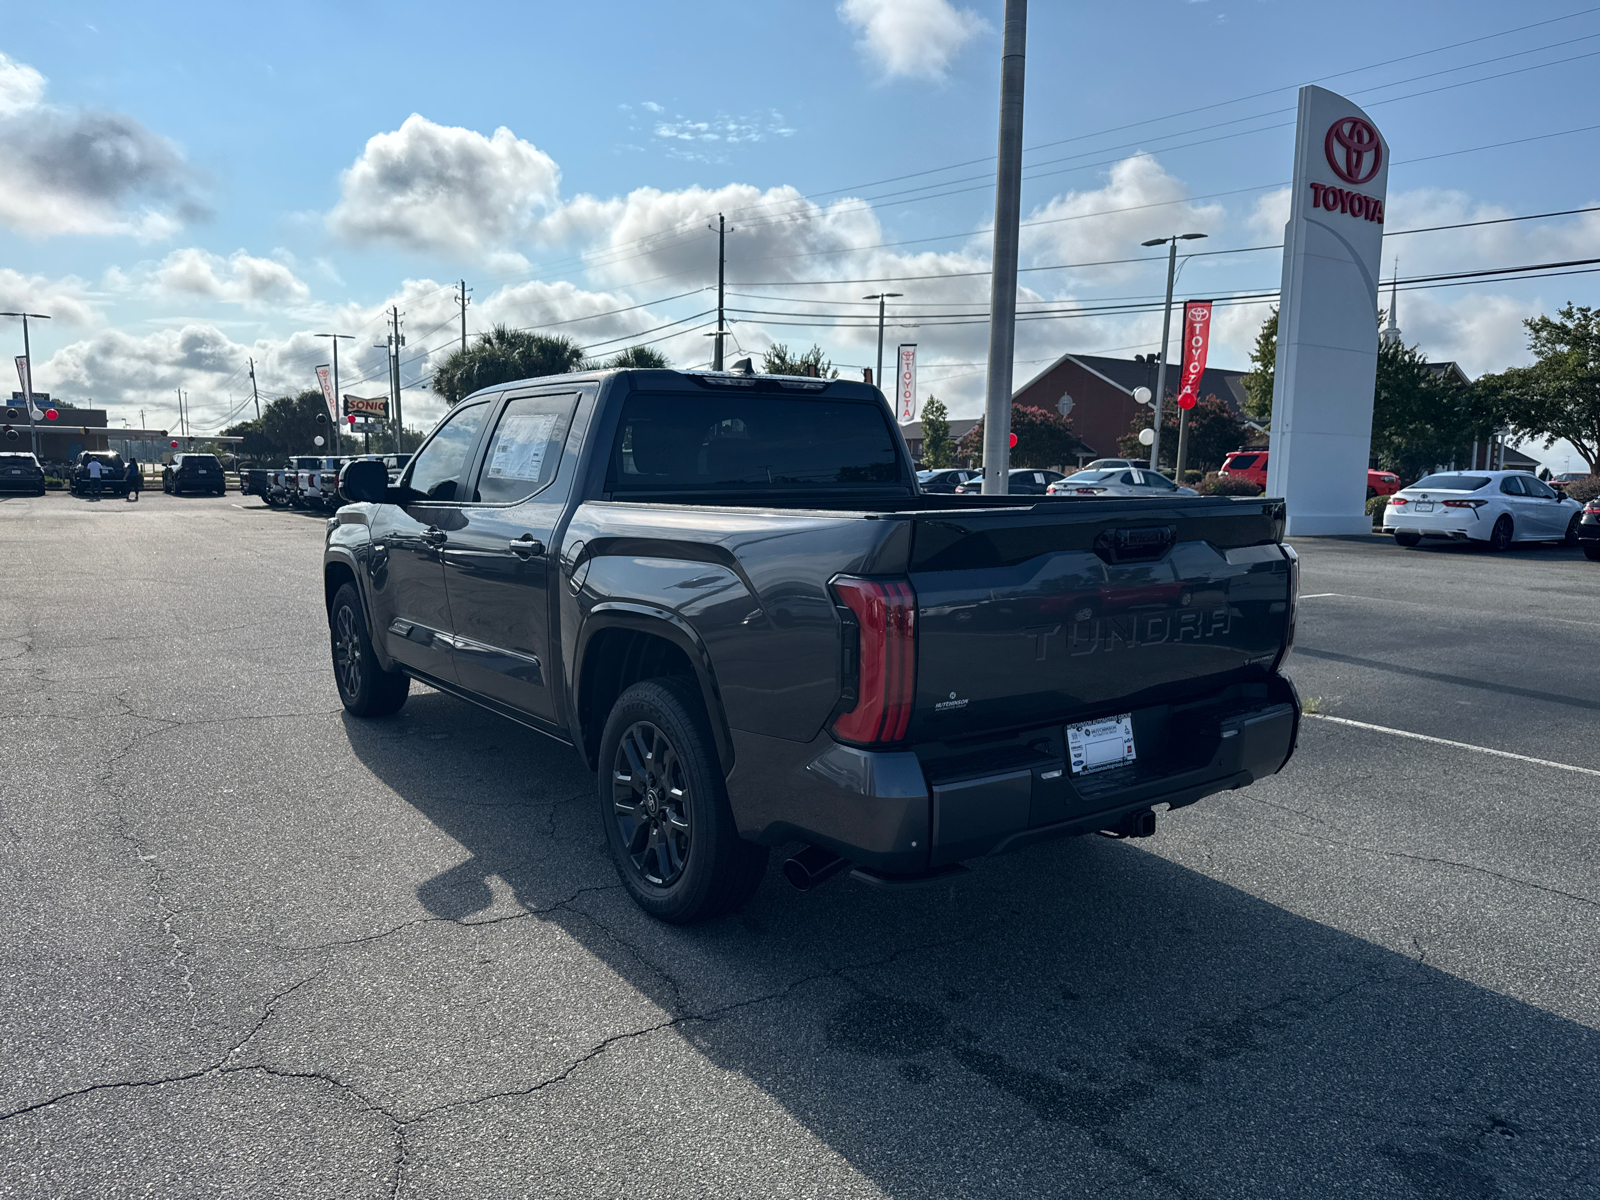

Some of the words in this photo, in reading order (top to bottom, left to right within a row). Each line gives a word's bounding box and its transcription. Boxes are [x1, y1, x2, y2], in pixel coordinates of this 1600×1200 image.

[1310, 182, 1384, 225] TOYOTA
[1183, 323, 1203, 394] TOYOTA
[349, 400, 385, 411] SONIC
[903, 362, 912, 417] TOYOTA
[1021, 603, 1231, 662] TUNDRA
[935, 698, 969, 709] HUTCHINSON
